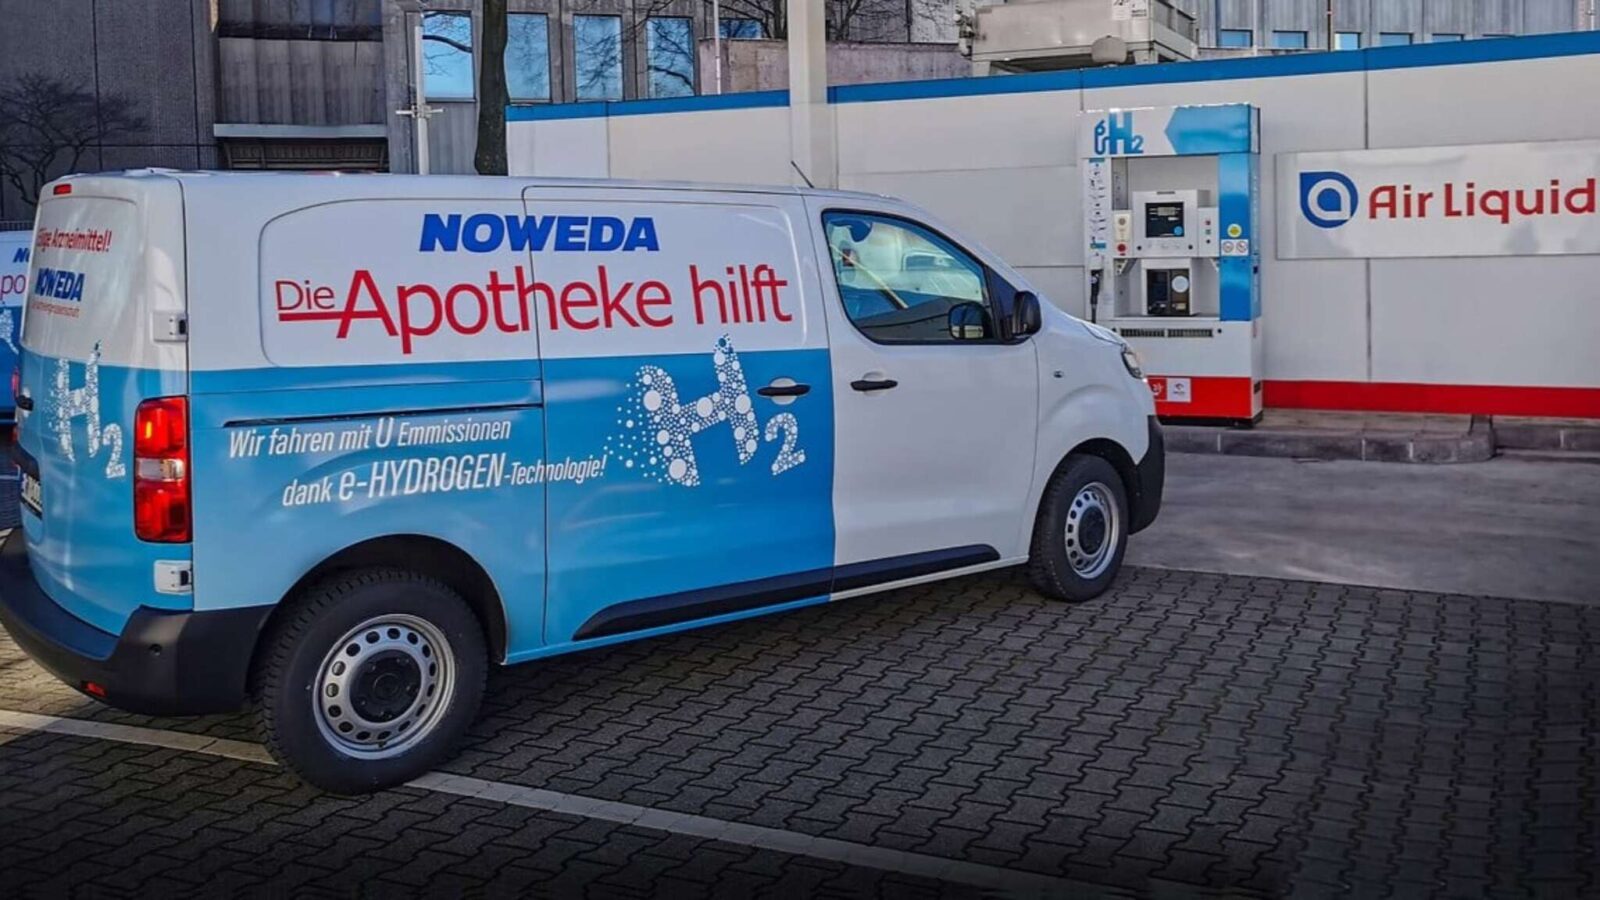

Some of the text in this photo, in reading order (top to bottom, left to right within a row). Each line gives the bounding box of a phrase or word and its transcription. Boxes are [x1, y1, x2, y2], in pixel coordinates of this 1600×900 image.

[1369, 178, 1596, 224] Air Liquid
[419, 213, 660, 253] NOWEDA
[275, 264, 793, 355] Die Apotheke hilft
[229, 429, 267, 458] Wir
[268, 428, 336, 454] fahren
[339, 424, 374, 450] mit
[397, 420, 512, 446] Emmissionen
[282, 478, 332, 507] dank
